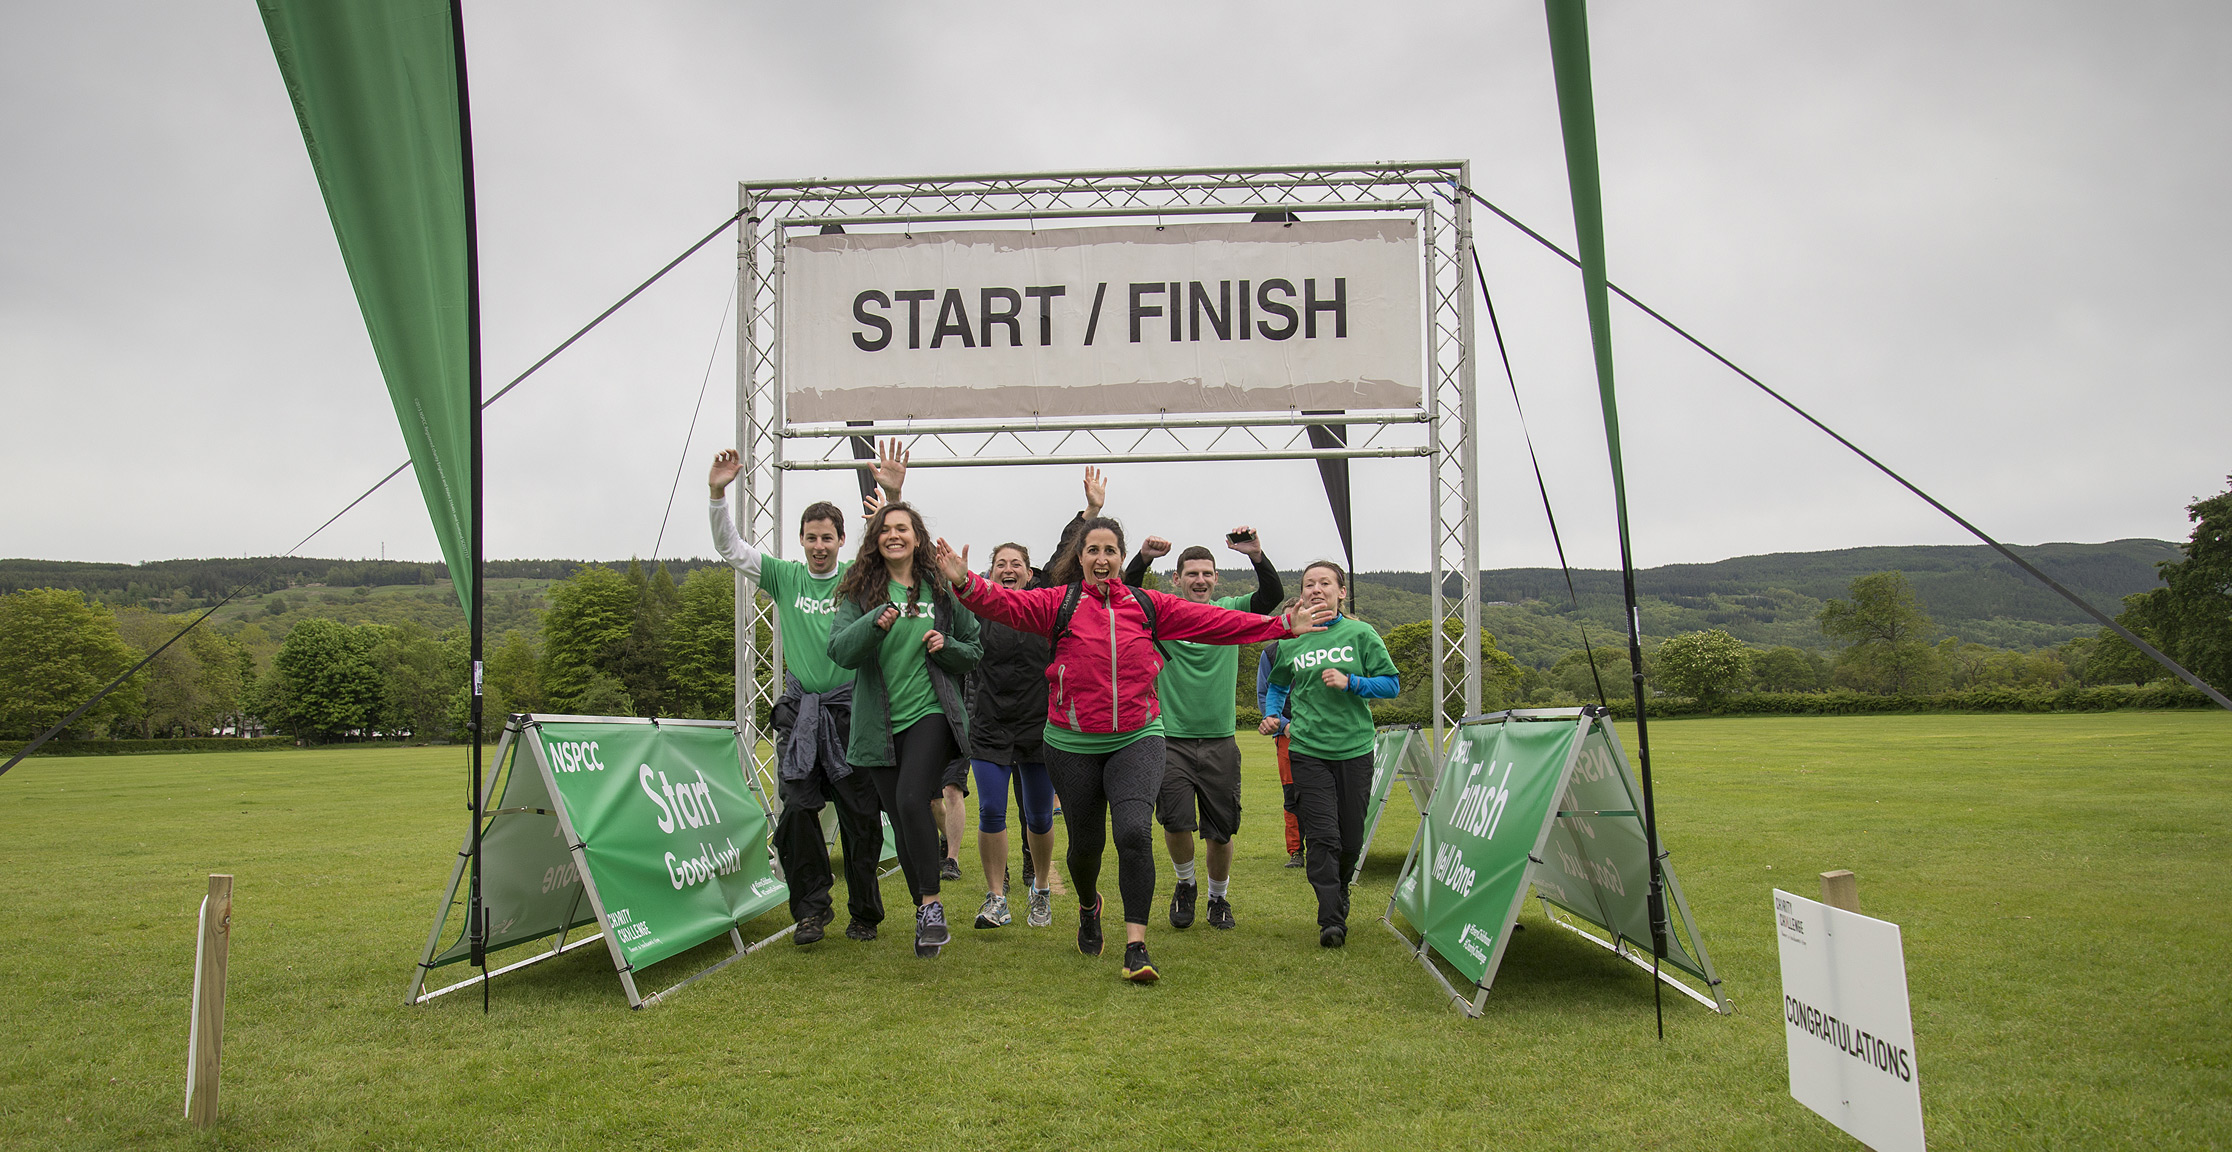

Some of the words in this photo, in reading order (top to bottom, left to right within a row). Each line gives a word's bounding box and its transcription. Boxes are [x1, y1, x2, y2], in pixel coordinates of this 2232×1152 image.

[851, 284, 1066, 352] START
[1083, 281, 1108, 347] /
[1129, 276, 1348, 343] FINISH
[1293, 645, 1354, 672] NSPCC
[548, 741, 605, 774] NSPCC
[639, 762, 721, 834] Start
[1448, 759, 1514, 841] Finish
[664, 842, 717, 891] Good
[708, 836, 741, 876] Luck
[1431, 841, 1457, 883] Well
[1444, 849, 1476, 898] Done
[1785, 994, 1911, 1084] CONGRATULATIONS
